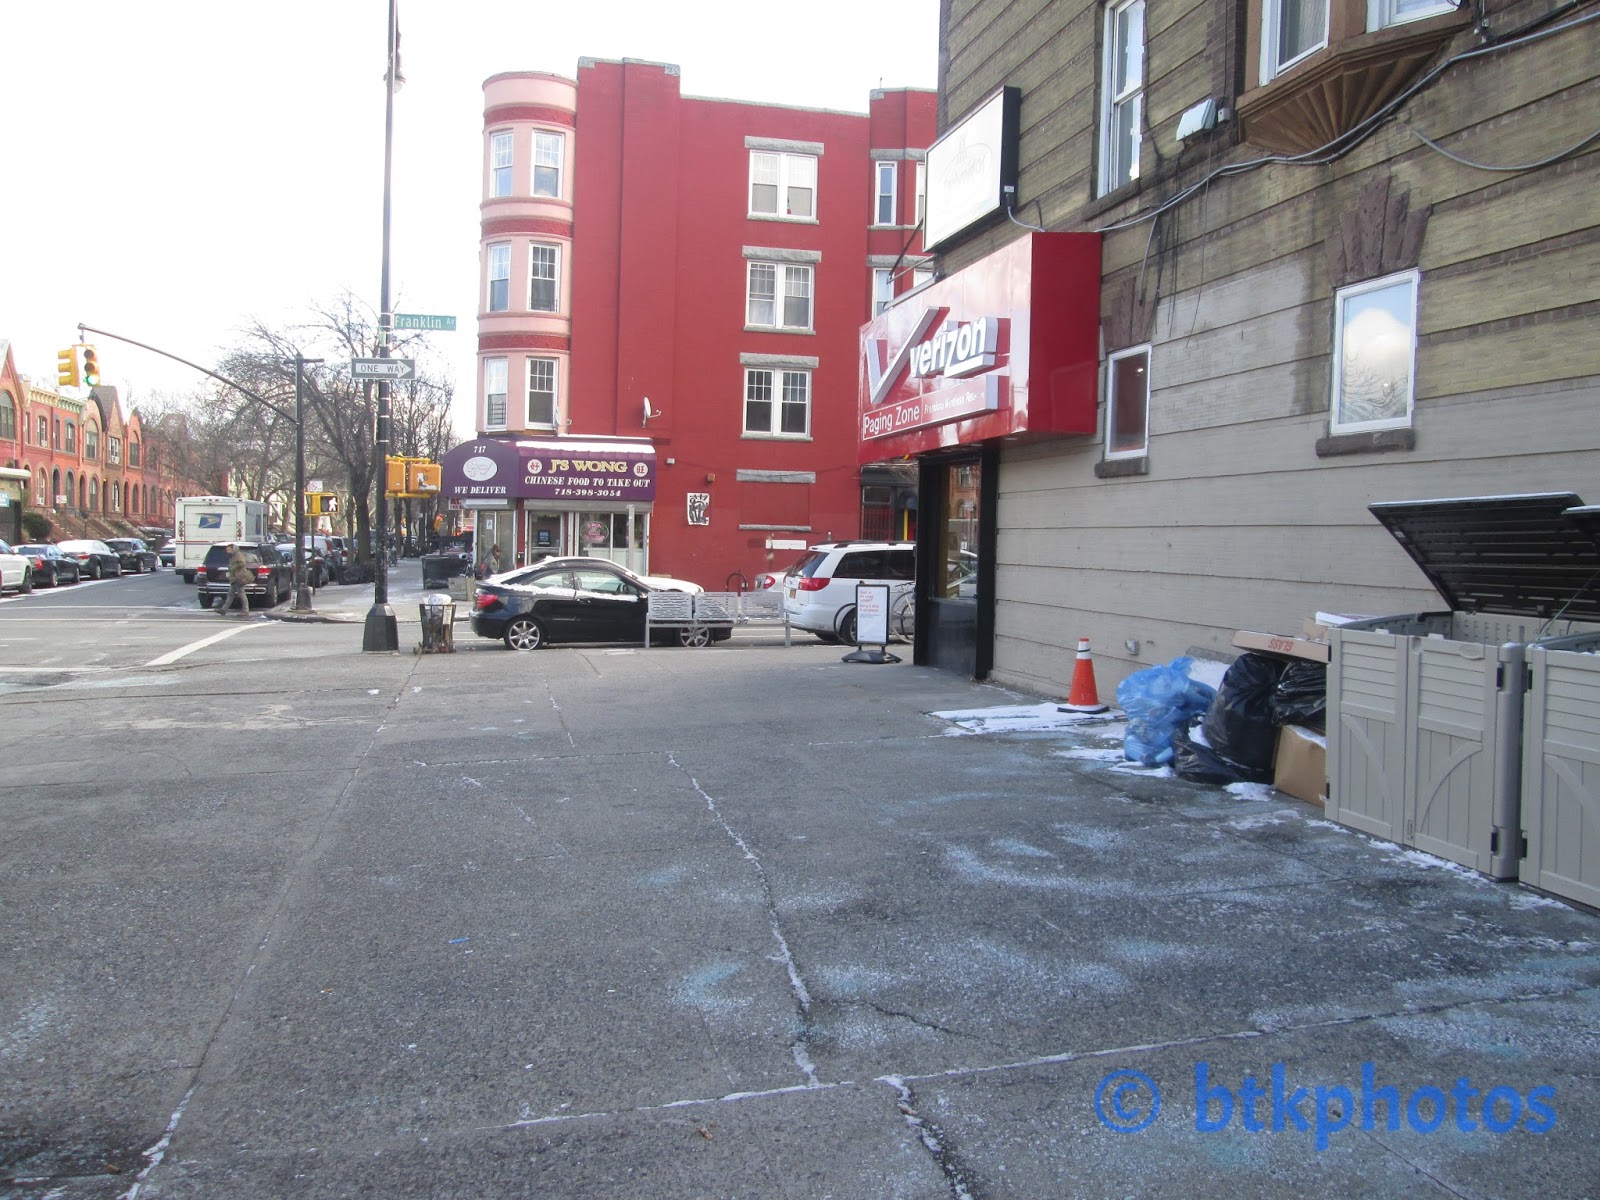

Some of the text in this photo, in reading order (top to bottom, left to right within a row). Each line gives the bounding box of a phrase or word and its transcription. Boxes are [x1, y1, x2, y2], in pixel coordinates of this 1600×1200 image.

[395, 315, 442, 328] Franklin
[909, 317, 987, 378] verizon
[360, 364, 406, 373] ONE WAY
[864, 405, 920, 434] Paging Zone
[572, 460, 628, 473] WONG
[524, 475, 651, 488] CHINESE FOOD TO TAKE OUT
[454, 486, 506, 494] WE DELIVER
[554, 488, 621, 497] 718-398-3054
[1268, 639, 1293, 651] GLASS
